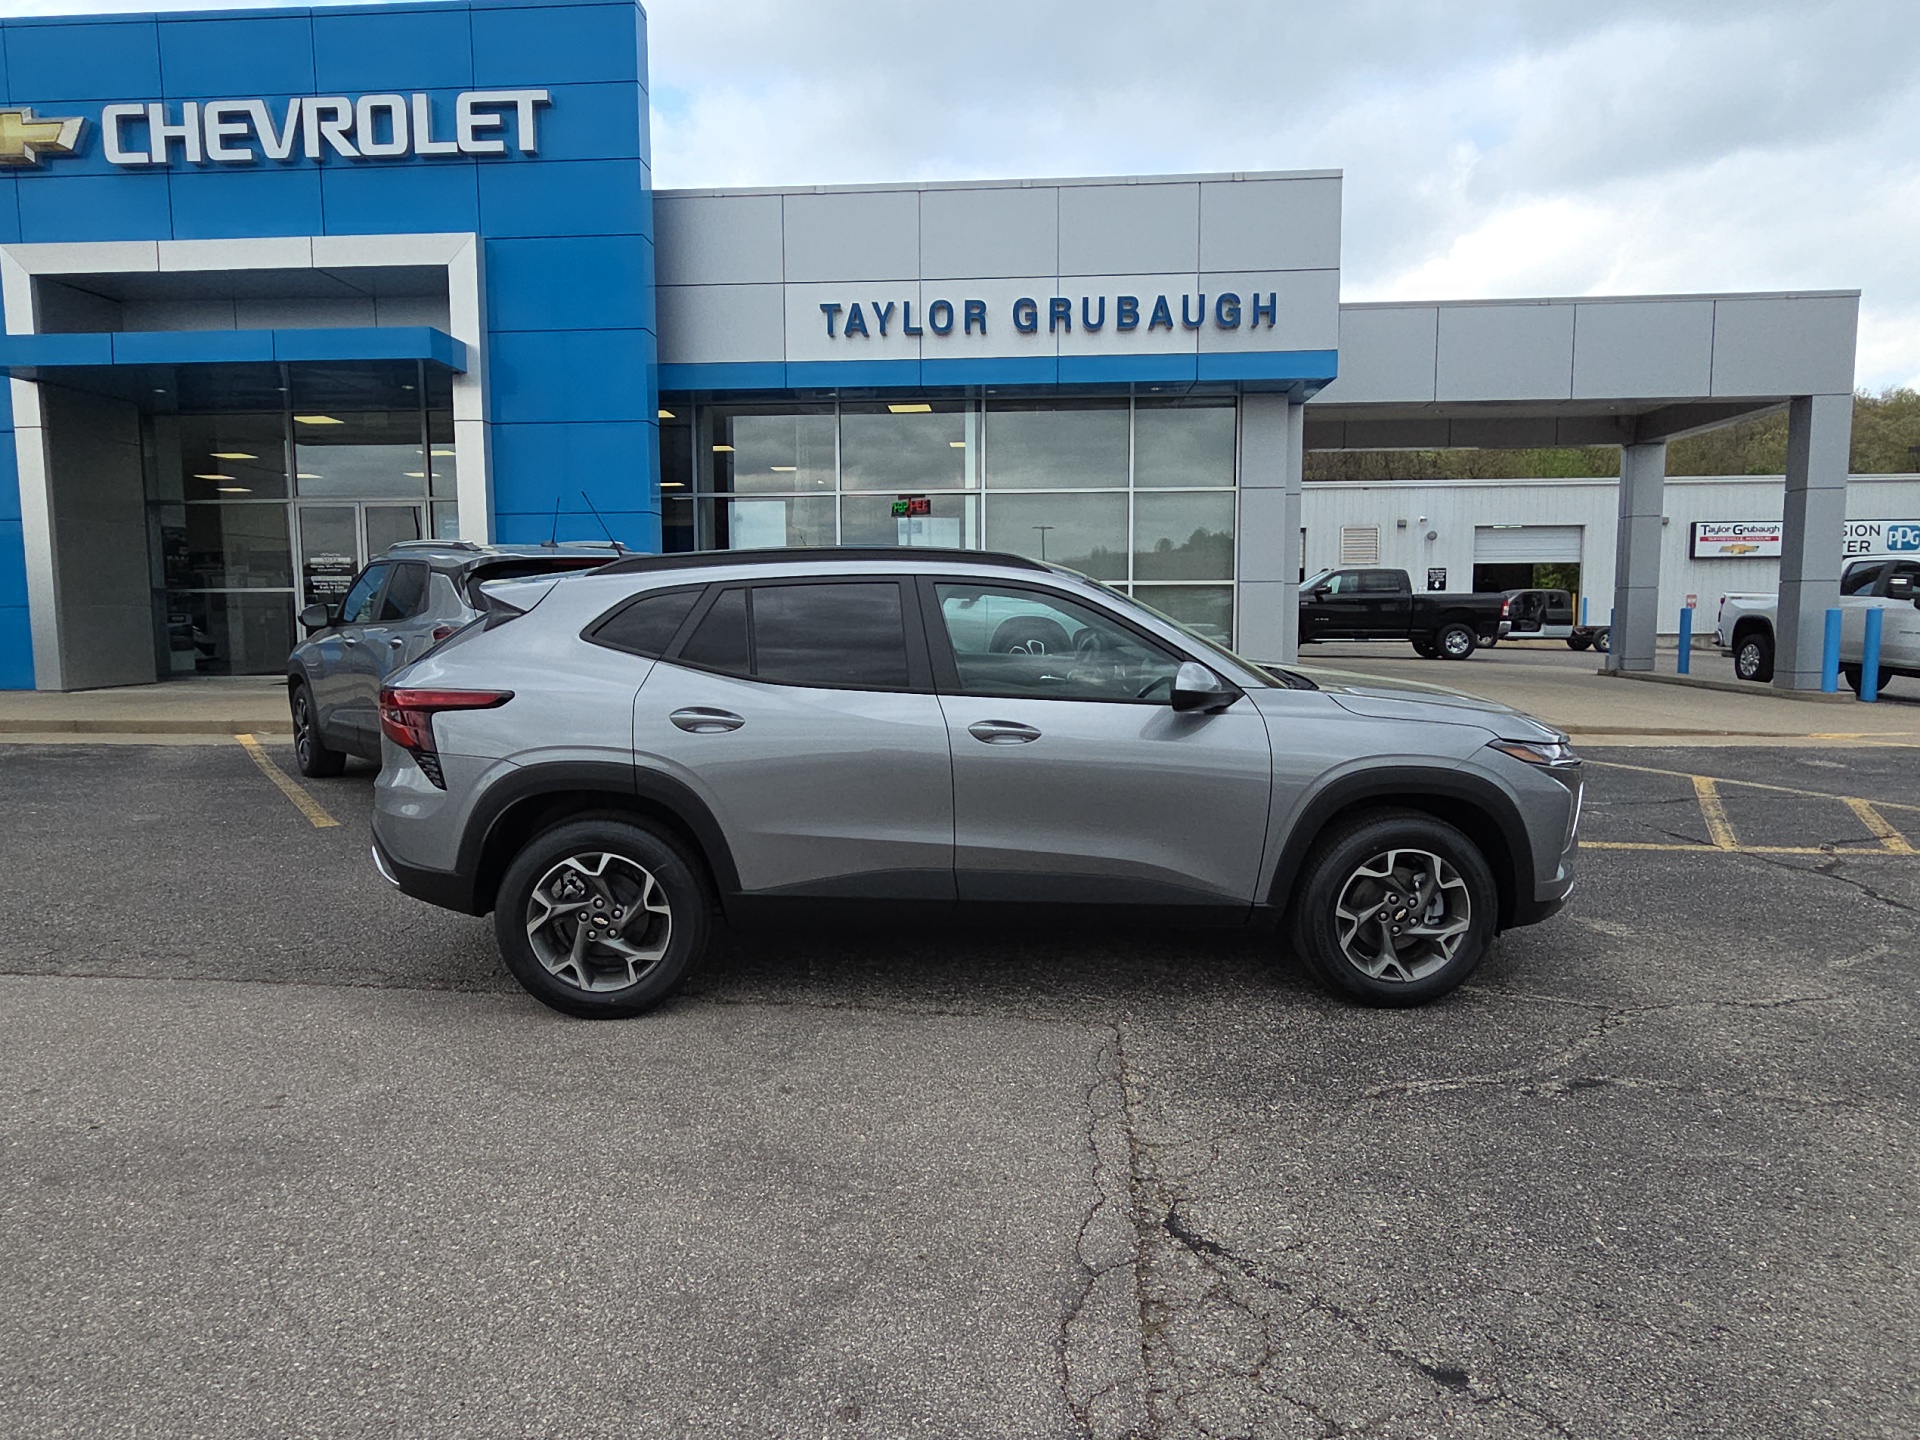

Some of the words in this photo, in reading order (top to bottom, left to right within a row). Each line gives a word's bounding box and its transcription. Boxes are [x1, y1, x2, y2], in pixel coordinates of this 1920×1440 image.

[102, 89, 551, 164] CHEVROLET
[820, 298, 988, 337] TAYLOR
[1012, 292, 1277, 333] GRUBAUGH
[1700, 525, 1731, 535] Taylor
[1733, 524, 1780, 535] Grubaugh
[1843, 540, 1871, 553] ER
